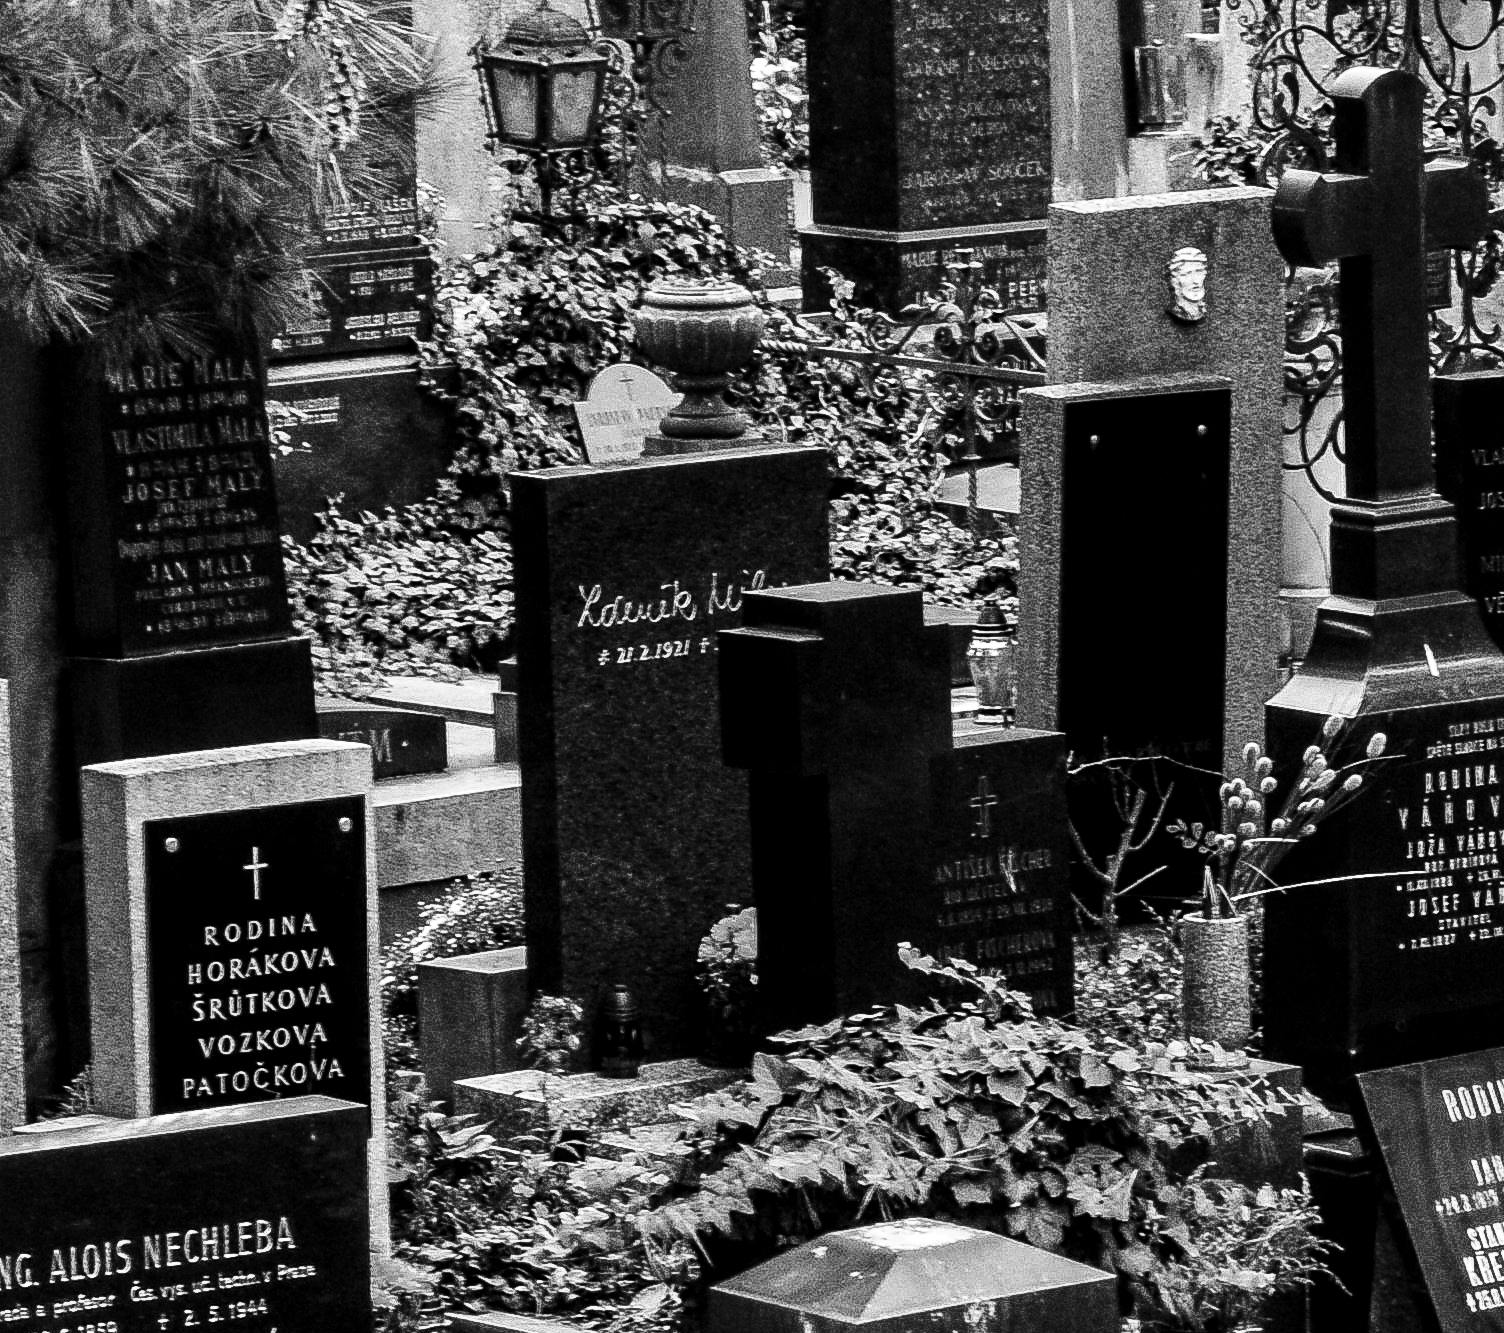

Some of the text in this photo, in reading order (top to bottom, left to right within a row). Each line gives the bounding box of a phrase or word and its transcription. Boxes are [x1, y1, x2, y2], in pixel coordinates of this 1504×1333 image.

[1407, 893, 1461, 918] JOSEF
[203, 911, 318, 948] RODINA
[187, 942, 336, 987] HORÁKOVA
[191, 983, 333, 1025] ŠRŮTKOVA
[198, 1022, 329, 1059] VOZKOVA
[182, 1056, 346, 1100] PATOČKOVA
[50, 1216, 297, 1284] ALOIS NECHLEBA
